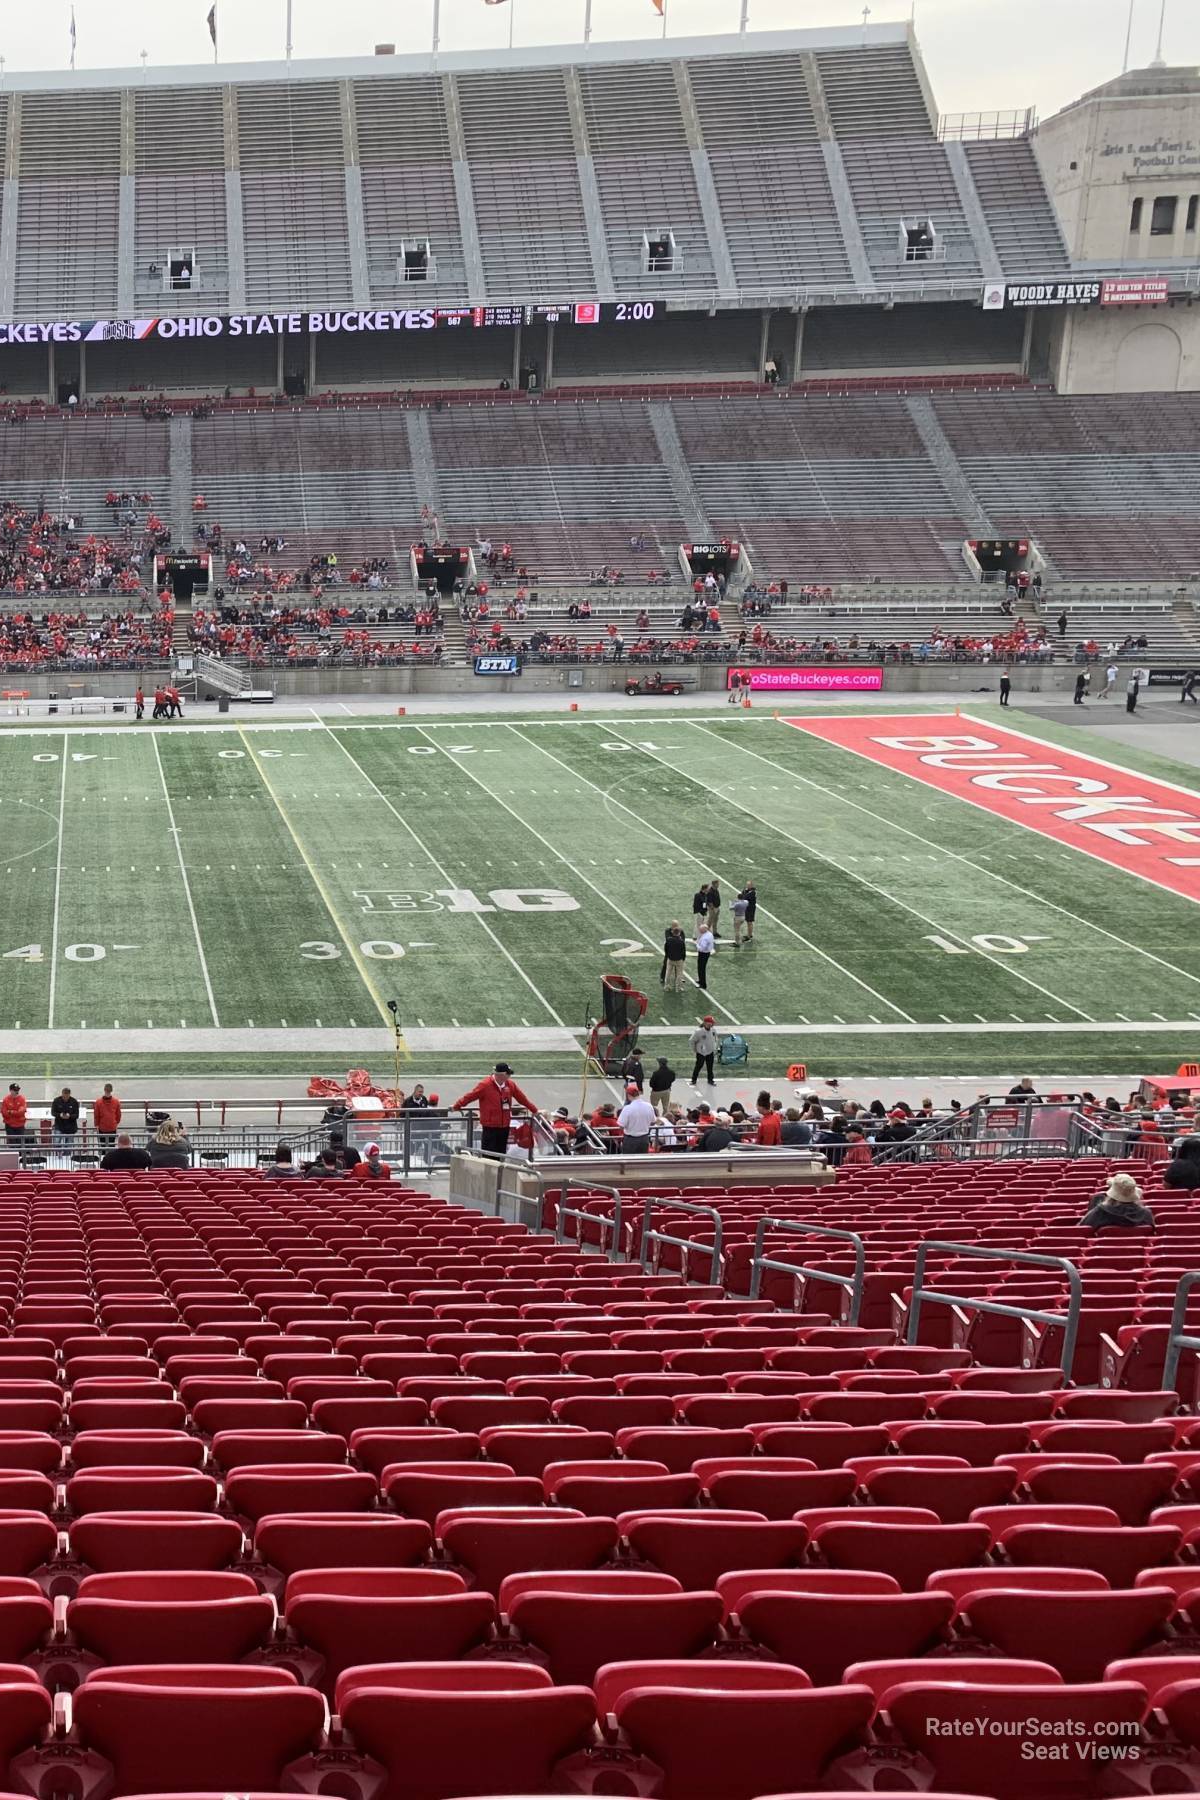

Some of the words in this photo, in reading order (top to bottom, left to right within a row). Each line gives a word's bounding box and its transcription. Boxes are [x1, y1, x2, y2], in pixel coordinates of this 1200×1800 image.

[1008, 285, 1054, 300] WOODY
[1057, 284, 1099, 298] HAYES
[615, 302, 654, 320] 2:00
[157, 317, 223, 338] OHIO
[228, 314, 301, 335] STATE
[308, 310, 435, 332] BUCKEYES
[479, 659, 512, 670] BTN
[751, 673, 879, 687] oStateBuckeyes.com
[3, 942, 107, 962] 40
[300, 939, 407, 960] 30
[922, 933, 1030, 954] 10
[793, 1066, 805, 1079] 20
[1185, 1065, 1197, 1076] 10
